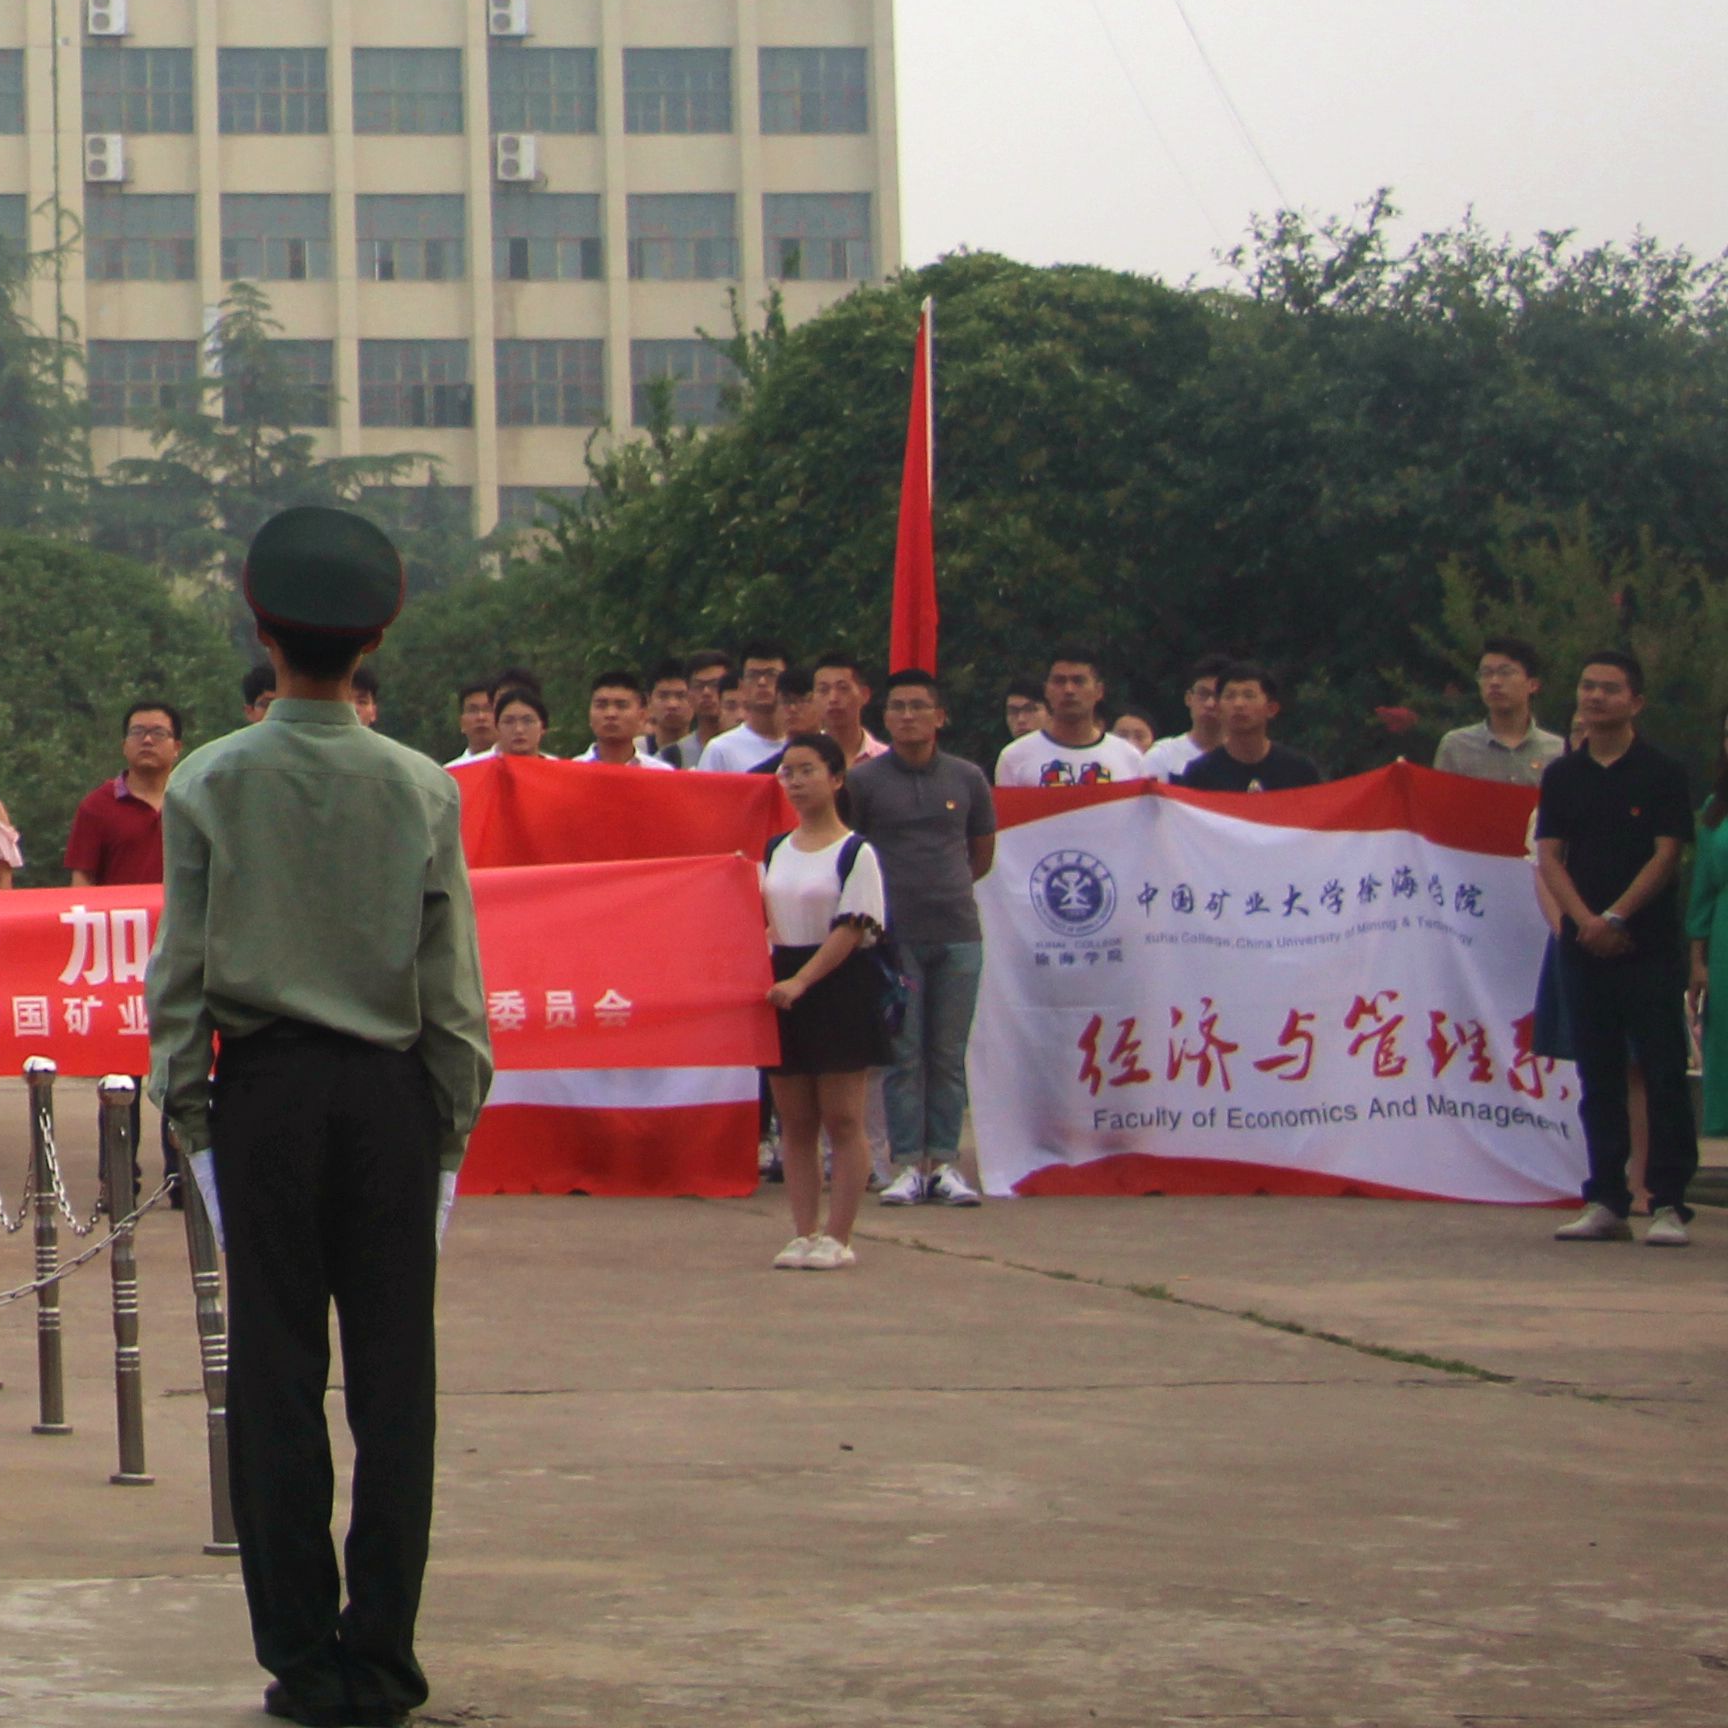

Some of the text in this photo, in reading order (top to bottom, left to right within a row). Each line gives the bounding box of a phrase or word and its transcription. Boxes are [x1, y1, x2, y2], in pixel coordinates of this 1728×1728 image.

[1275, 931, 1340, 948] University
[1356, 918, 1397, 933] Mining
[1093, 1105, 1182, 1131] Faculty
[1192, 1106, 1216, 1129] of
[1226, 1101, 1359, 1130] Economics
[1368, 1095, 1417, 1120] And
